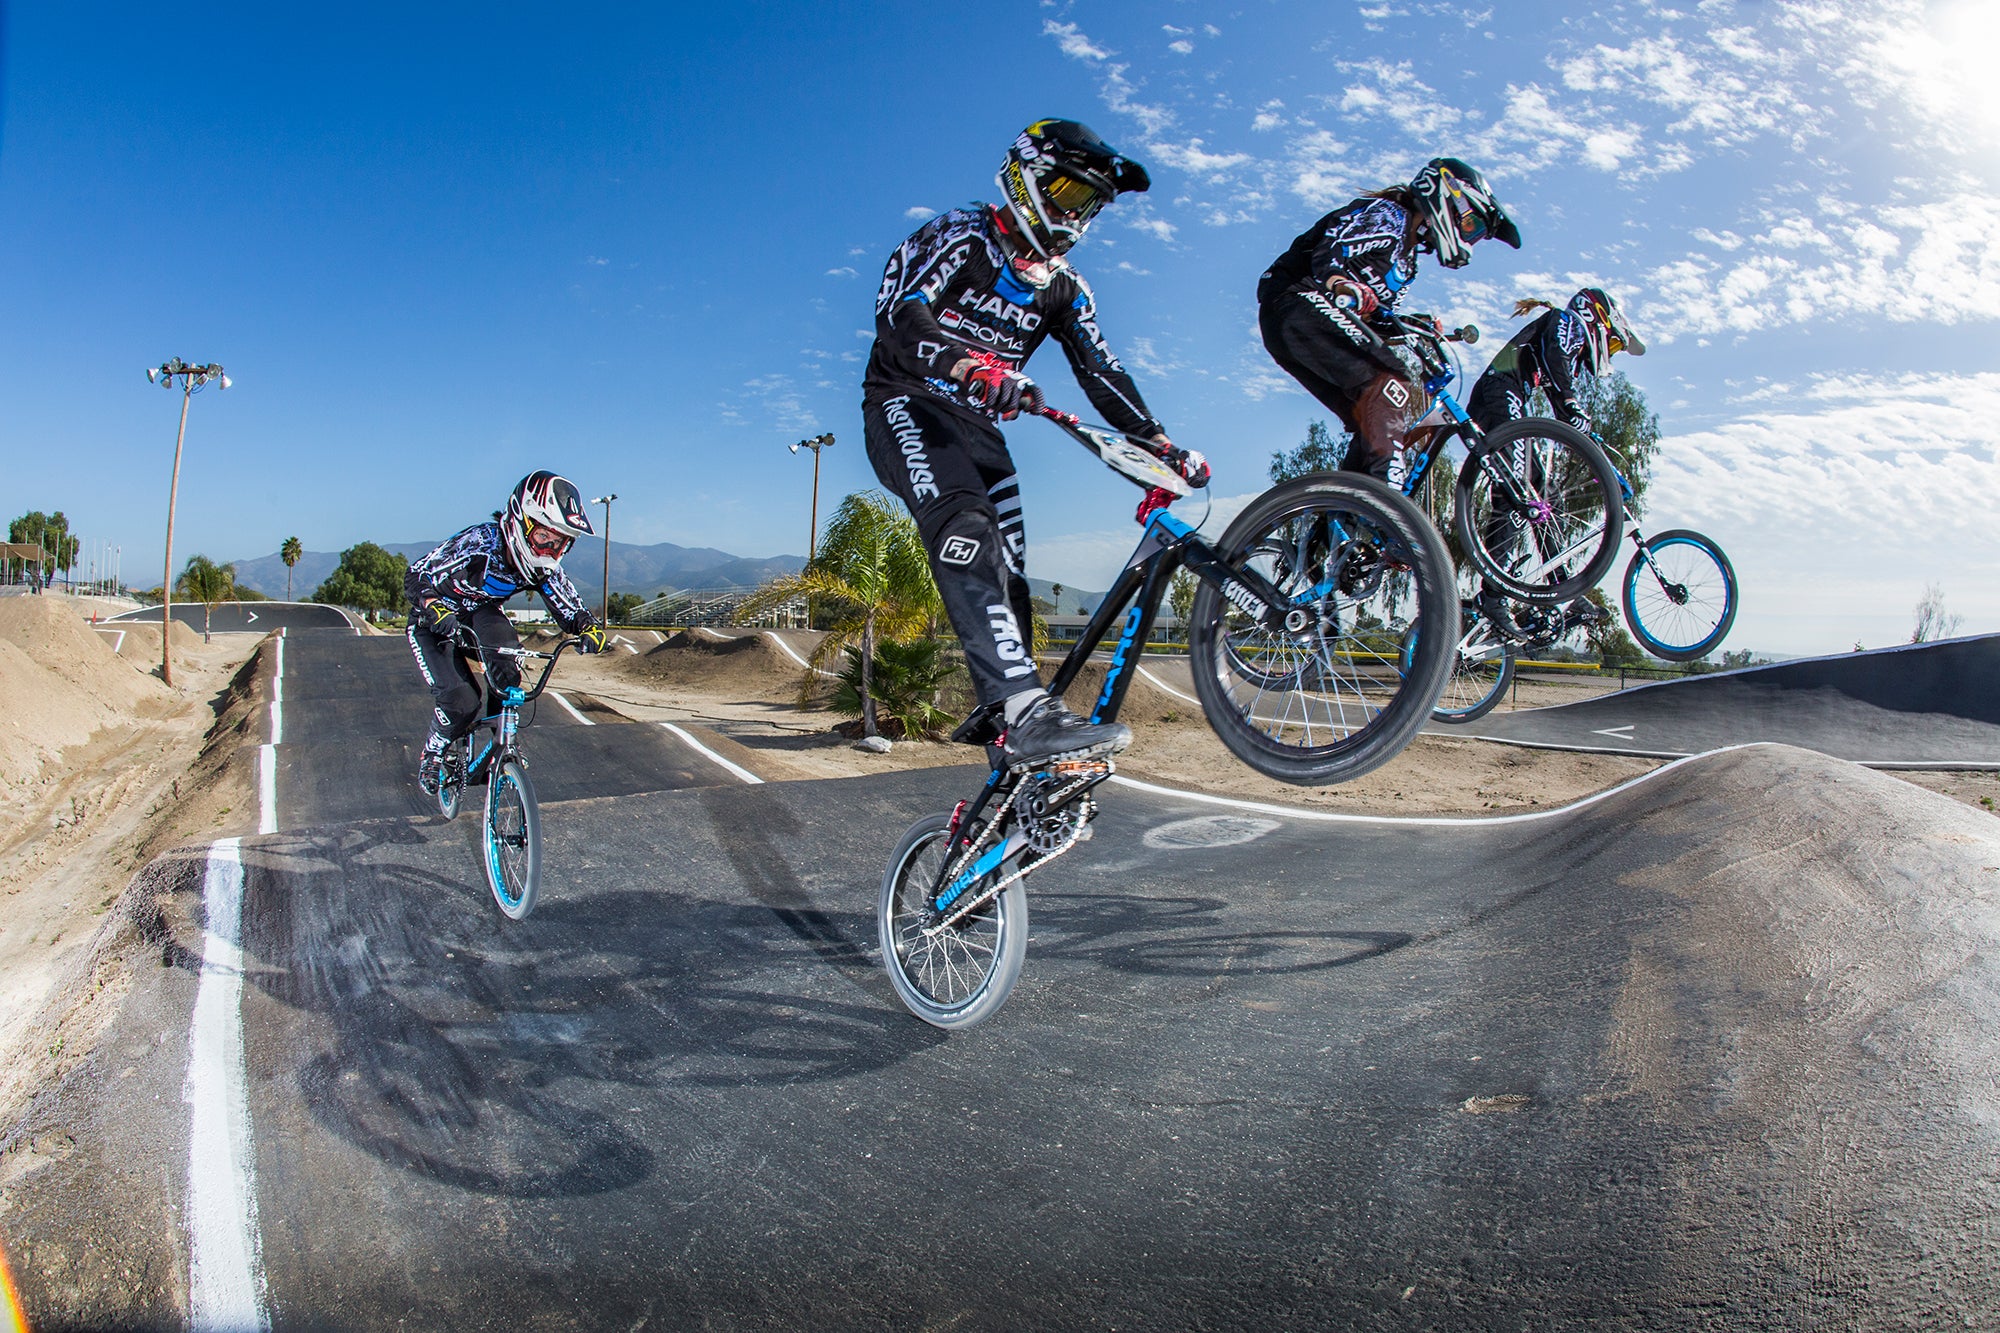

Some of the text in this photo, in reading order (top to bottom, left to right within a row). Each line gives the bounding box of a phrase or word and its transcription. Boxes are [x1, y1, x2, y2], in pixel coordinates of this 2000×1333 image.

[1009, 160, 1041, 227] ROCKR
[957, 287, 1043, 332] HARO
[1361, 266, 1393, 301] HAR
[882, 395, 940, 502] FASTHOUSE
